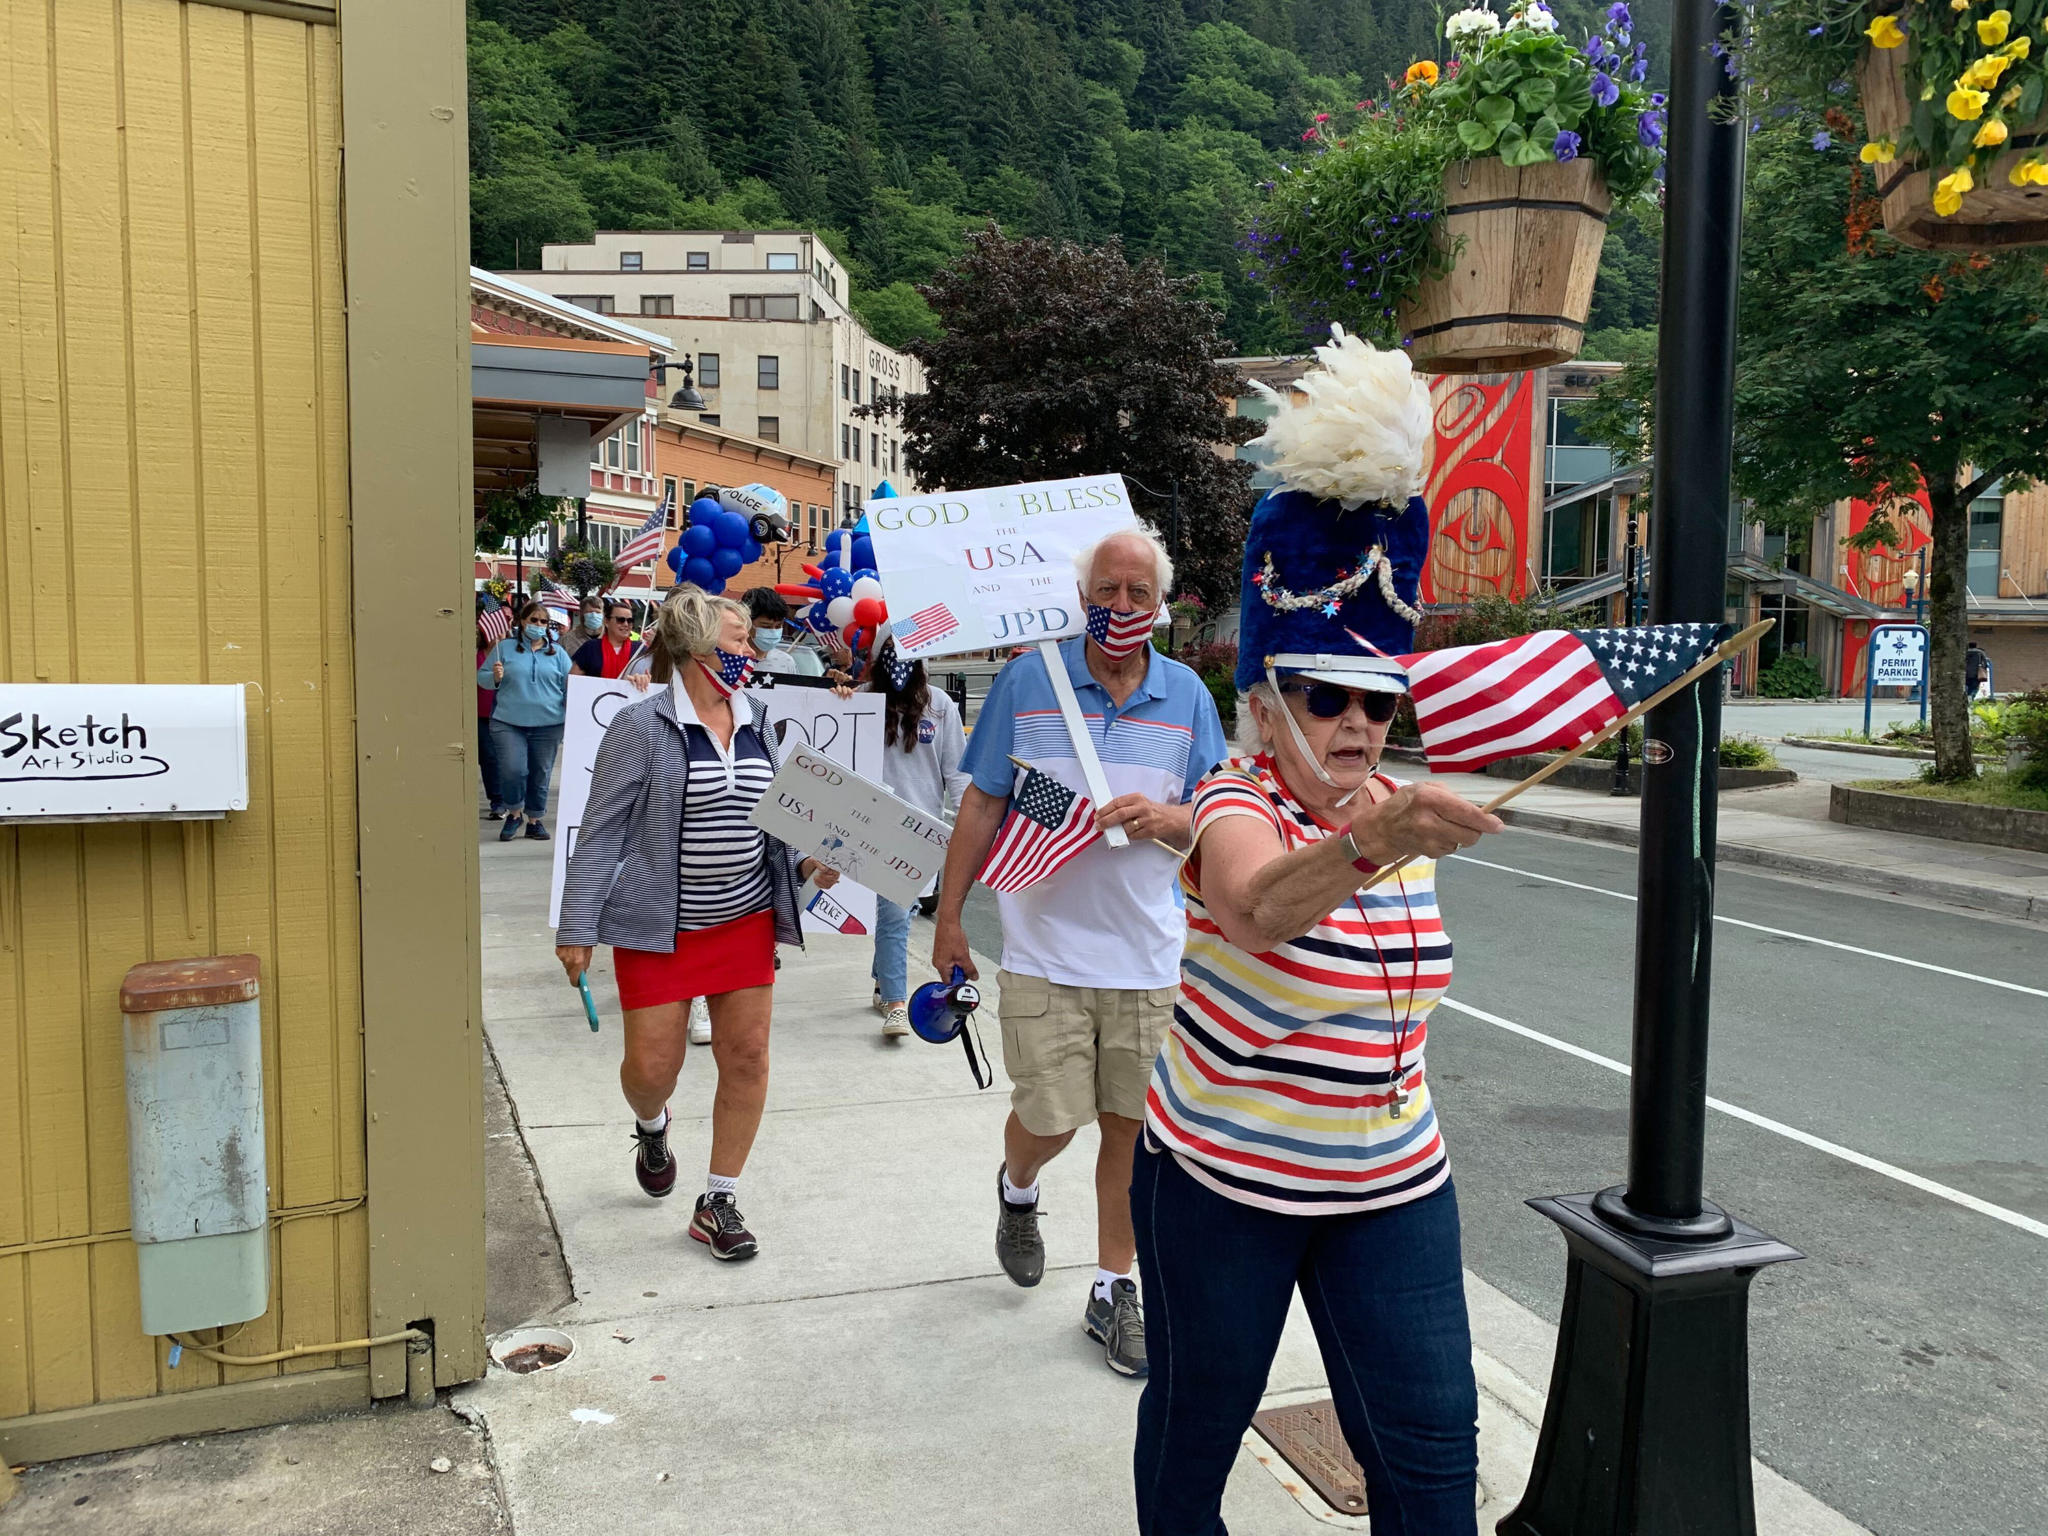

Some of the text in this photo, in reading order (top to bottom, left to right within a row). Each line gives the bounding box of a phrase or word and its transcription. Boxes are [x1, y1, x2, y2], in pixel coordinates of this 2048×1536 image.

[869, 348, 900, 381] GROSS
[722, 488, 763, 511] POLICE
[874, 483, 1122, 531] GOD BLESS
[995, 527, 1019, 536] THE
[964, 540, 1047, 571] USA
[972, 576, 1054, 595] AND THE
[992, 606, 1070, 640] JPD
[1878, 668, 1918, 676] PARKING
[0, 712, 147, 758] Sketch
[22, 749, 134, 771] Art Studio
[795, 755, 843, 787] GOD
[850, 808, 872, 825] THE
[778, 793, 922, 881] USA AND THE JPD
[815, 897, 842, 921] POLICE
